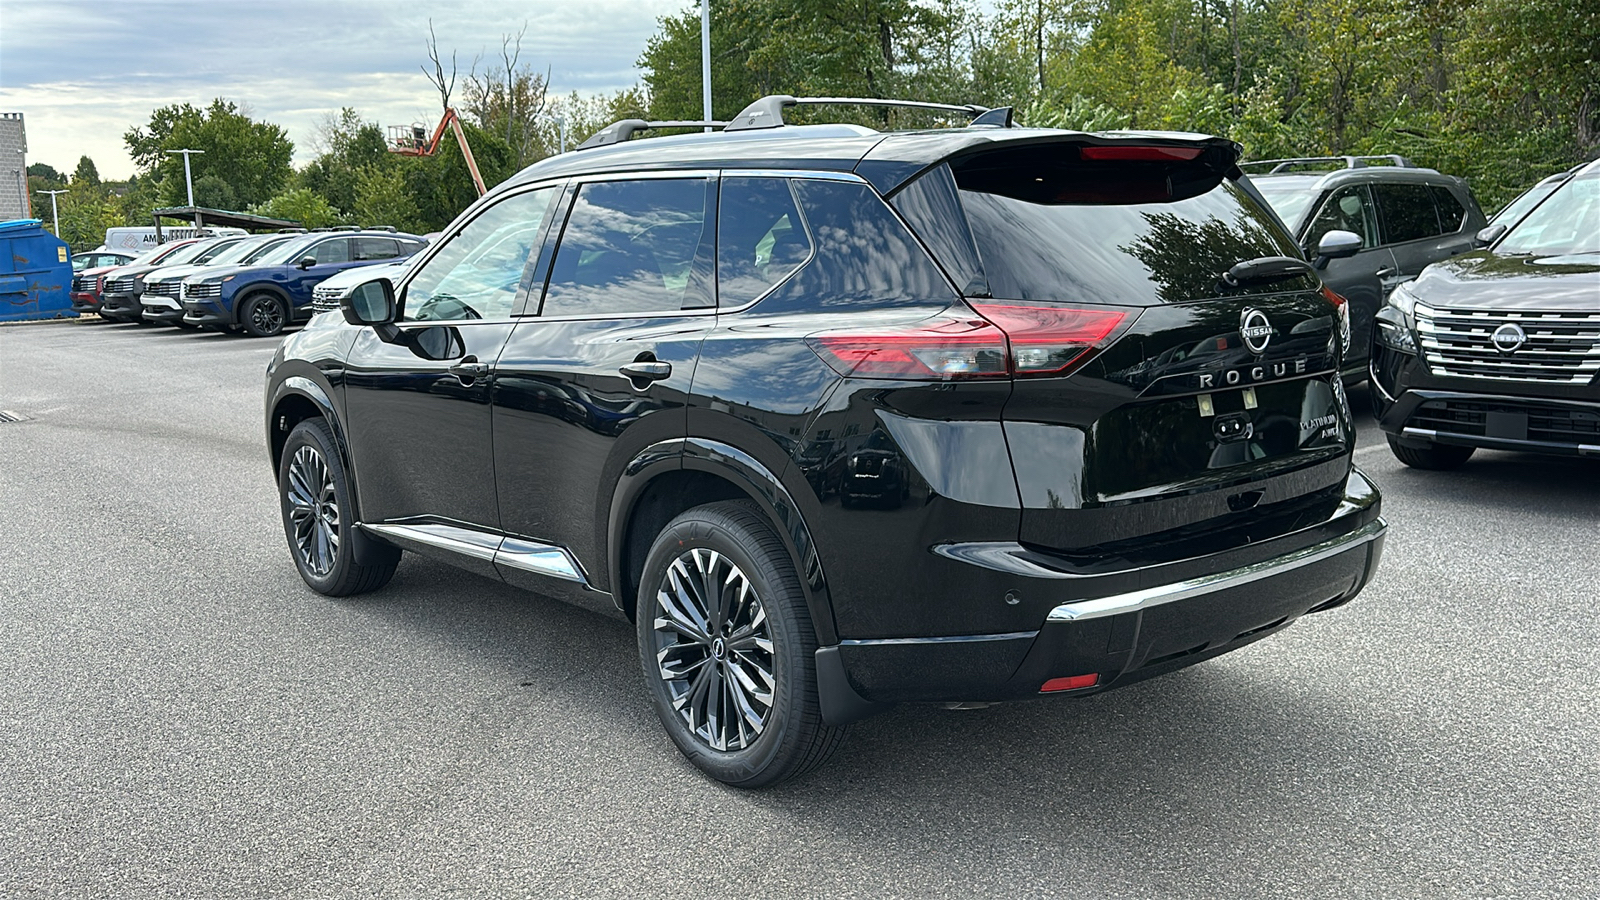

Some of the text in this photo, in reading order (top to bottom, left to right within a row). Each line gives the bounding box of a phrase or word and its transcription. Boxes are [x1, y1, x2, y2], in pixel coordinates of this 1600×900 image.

[1242, 327, 1273, 338] NISSAN
[1491, 334, 1526, 342] NISSAN
[1199, 359, 1307, 389] ROGUE
[1300, 414, 1336, 430] PLATINUM
